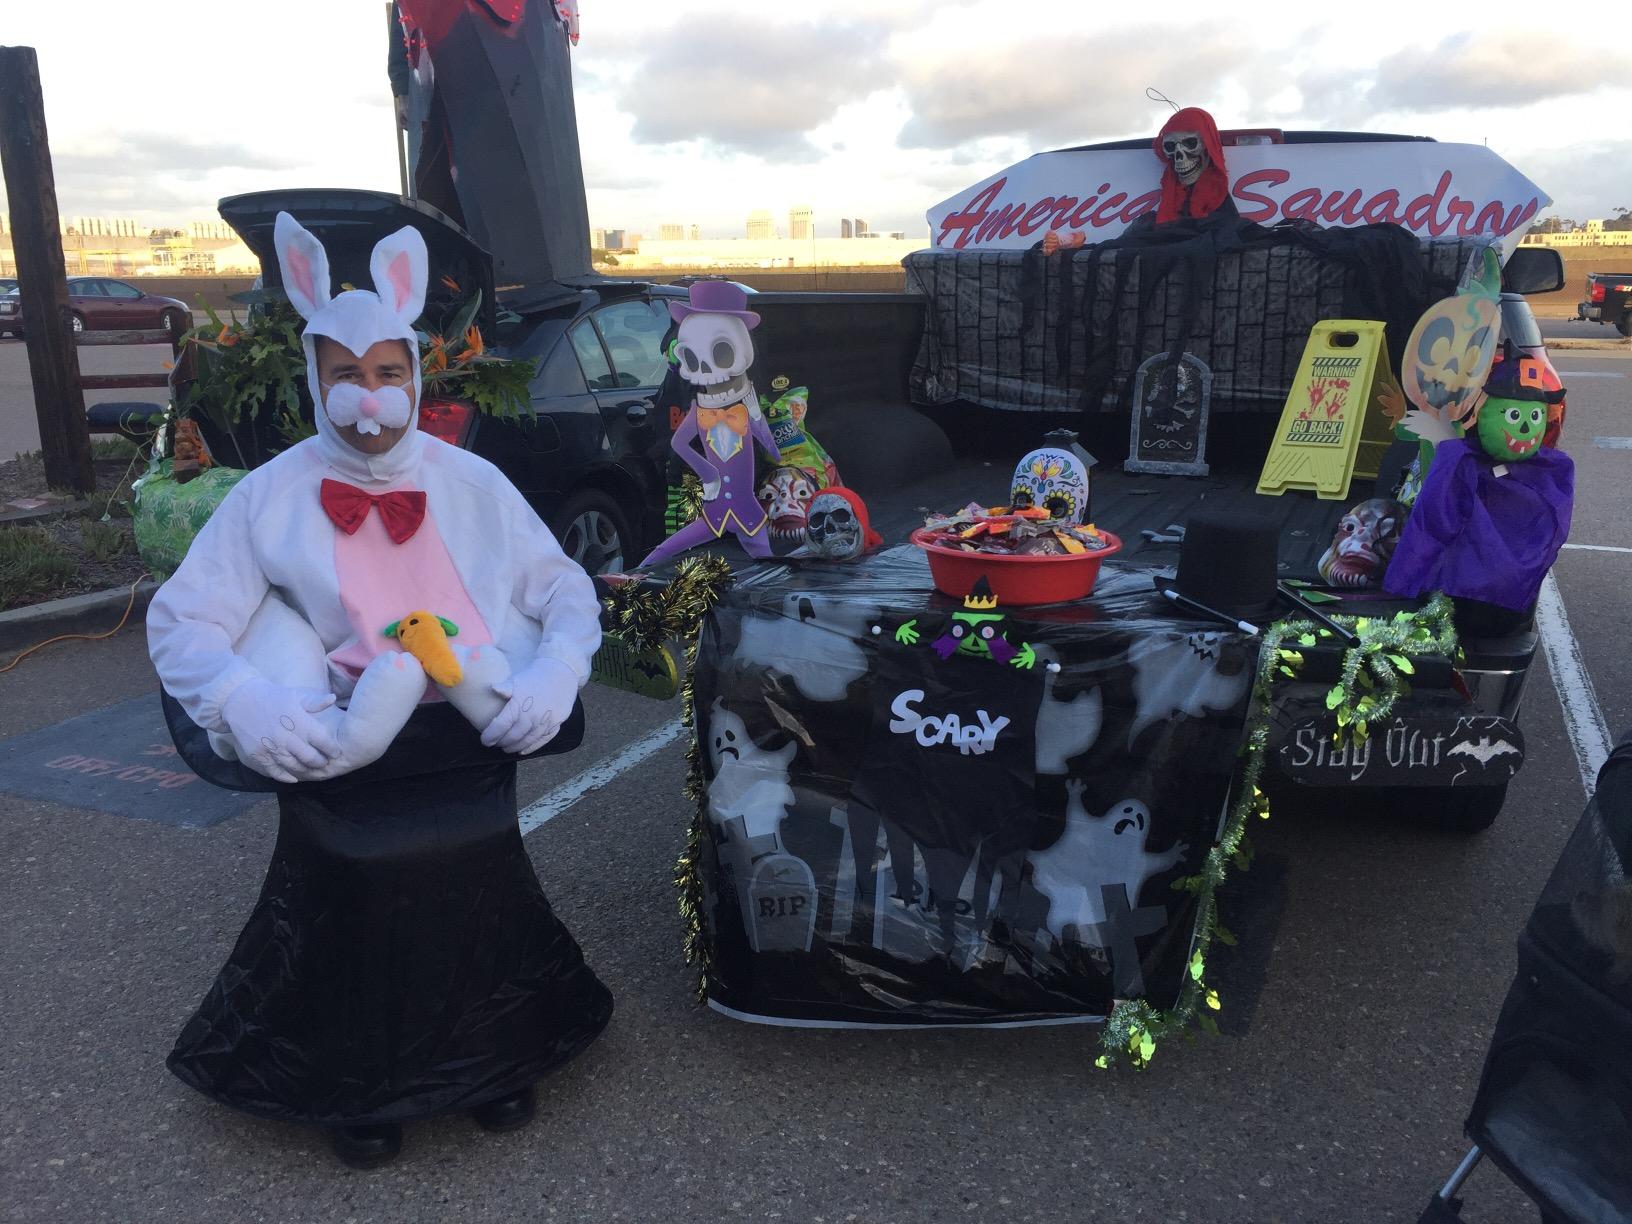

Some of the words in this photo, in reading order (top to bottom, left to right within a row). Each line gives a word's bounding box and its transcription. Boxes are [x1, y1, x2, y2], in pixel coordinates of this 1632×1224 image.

[936, 176, 1163, 249] America
[1312, 366, 1357, 377] WARNING
[773, 421, 795, 438] OLLY
[1292, 421, 1306, 432] GO
[1309, 421, 1344, 434] BACK!
[889, 689, 1011, 755] SCARY
[758, 895, 807, 918] RIP
